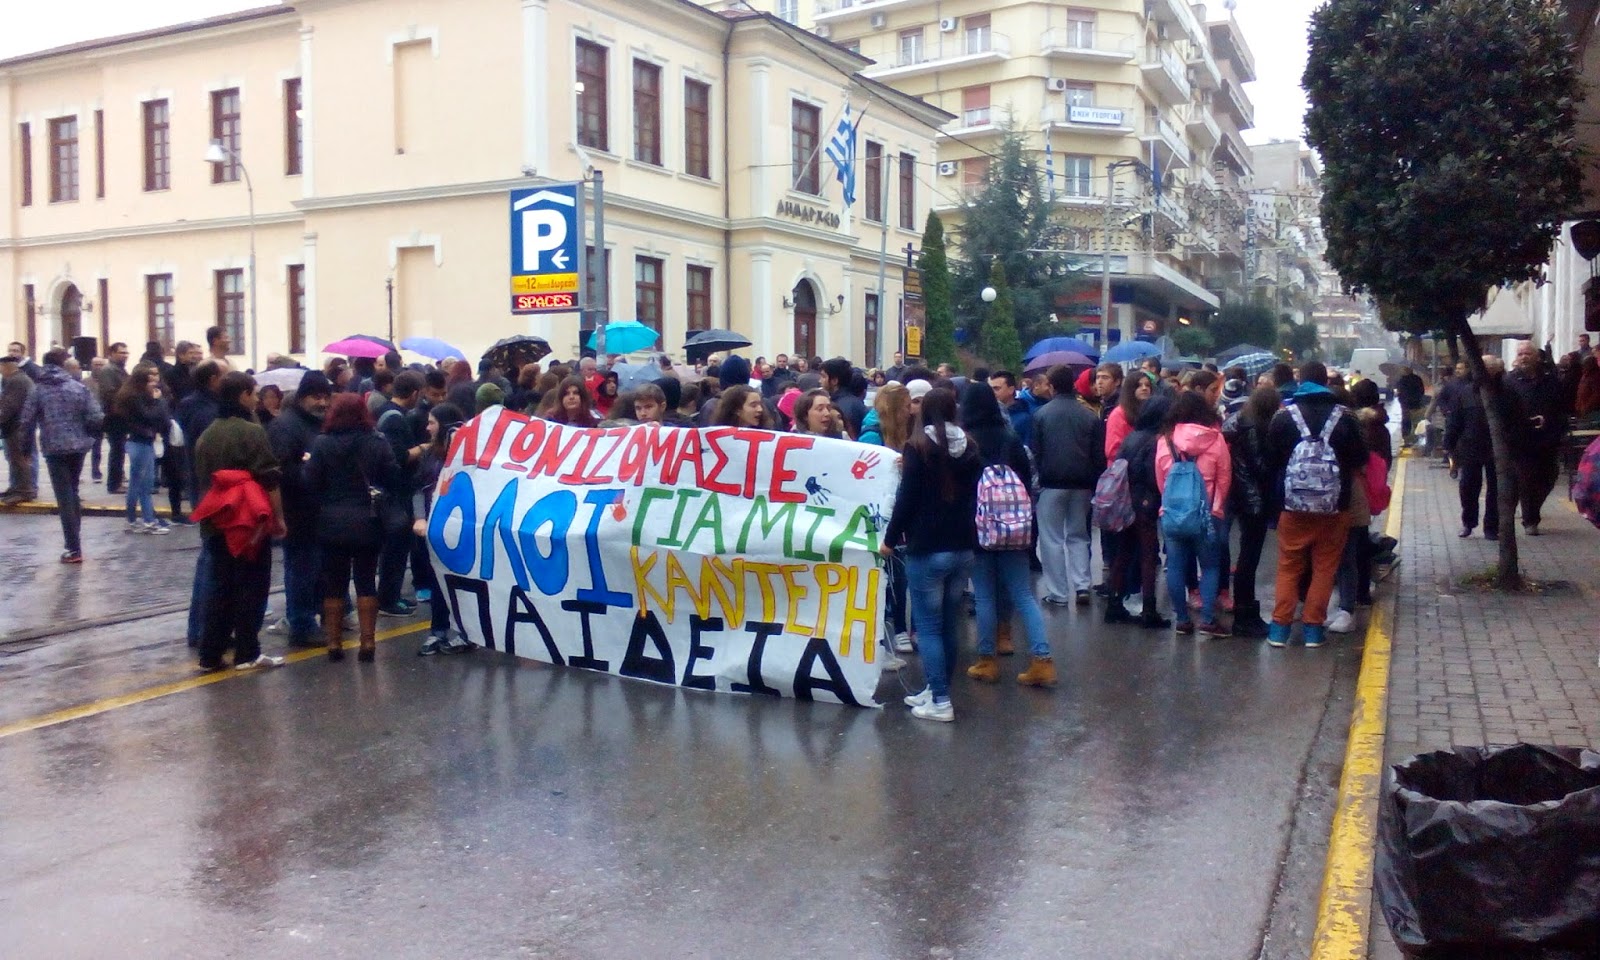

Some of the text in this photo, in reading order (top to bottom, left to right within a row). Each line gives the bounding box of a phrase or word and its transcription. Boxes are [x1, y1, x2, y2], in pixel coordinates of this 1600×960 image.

[522, 209, 567, 271] P
[776, 199, 840, 228] ΔΗΜΑΡΧΕΙΟ
[518, 295, 572, 309] SPACES
[526, 277, 537, 289] 12
[428, 471, 882, 608] ΟΛΟΙ ΓΙΑ ΜΙΑ
[630, 546, 880, 664] ΚΑΛΥΤΕΡΗ
[444, 574, 876, 707] ΠΑΙΔΕΙΑ
